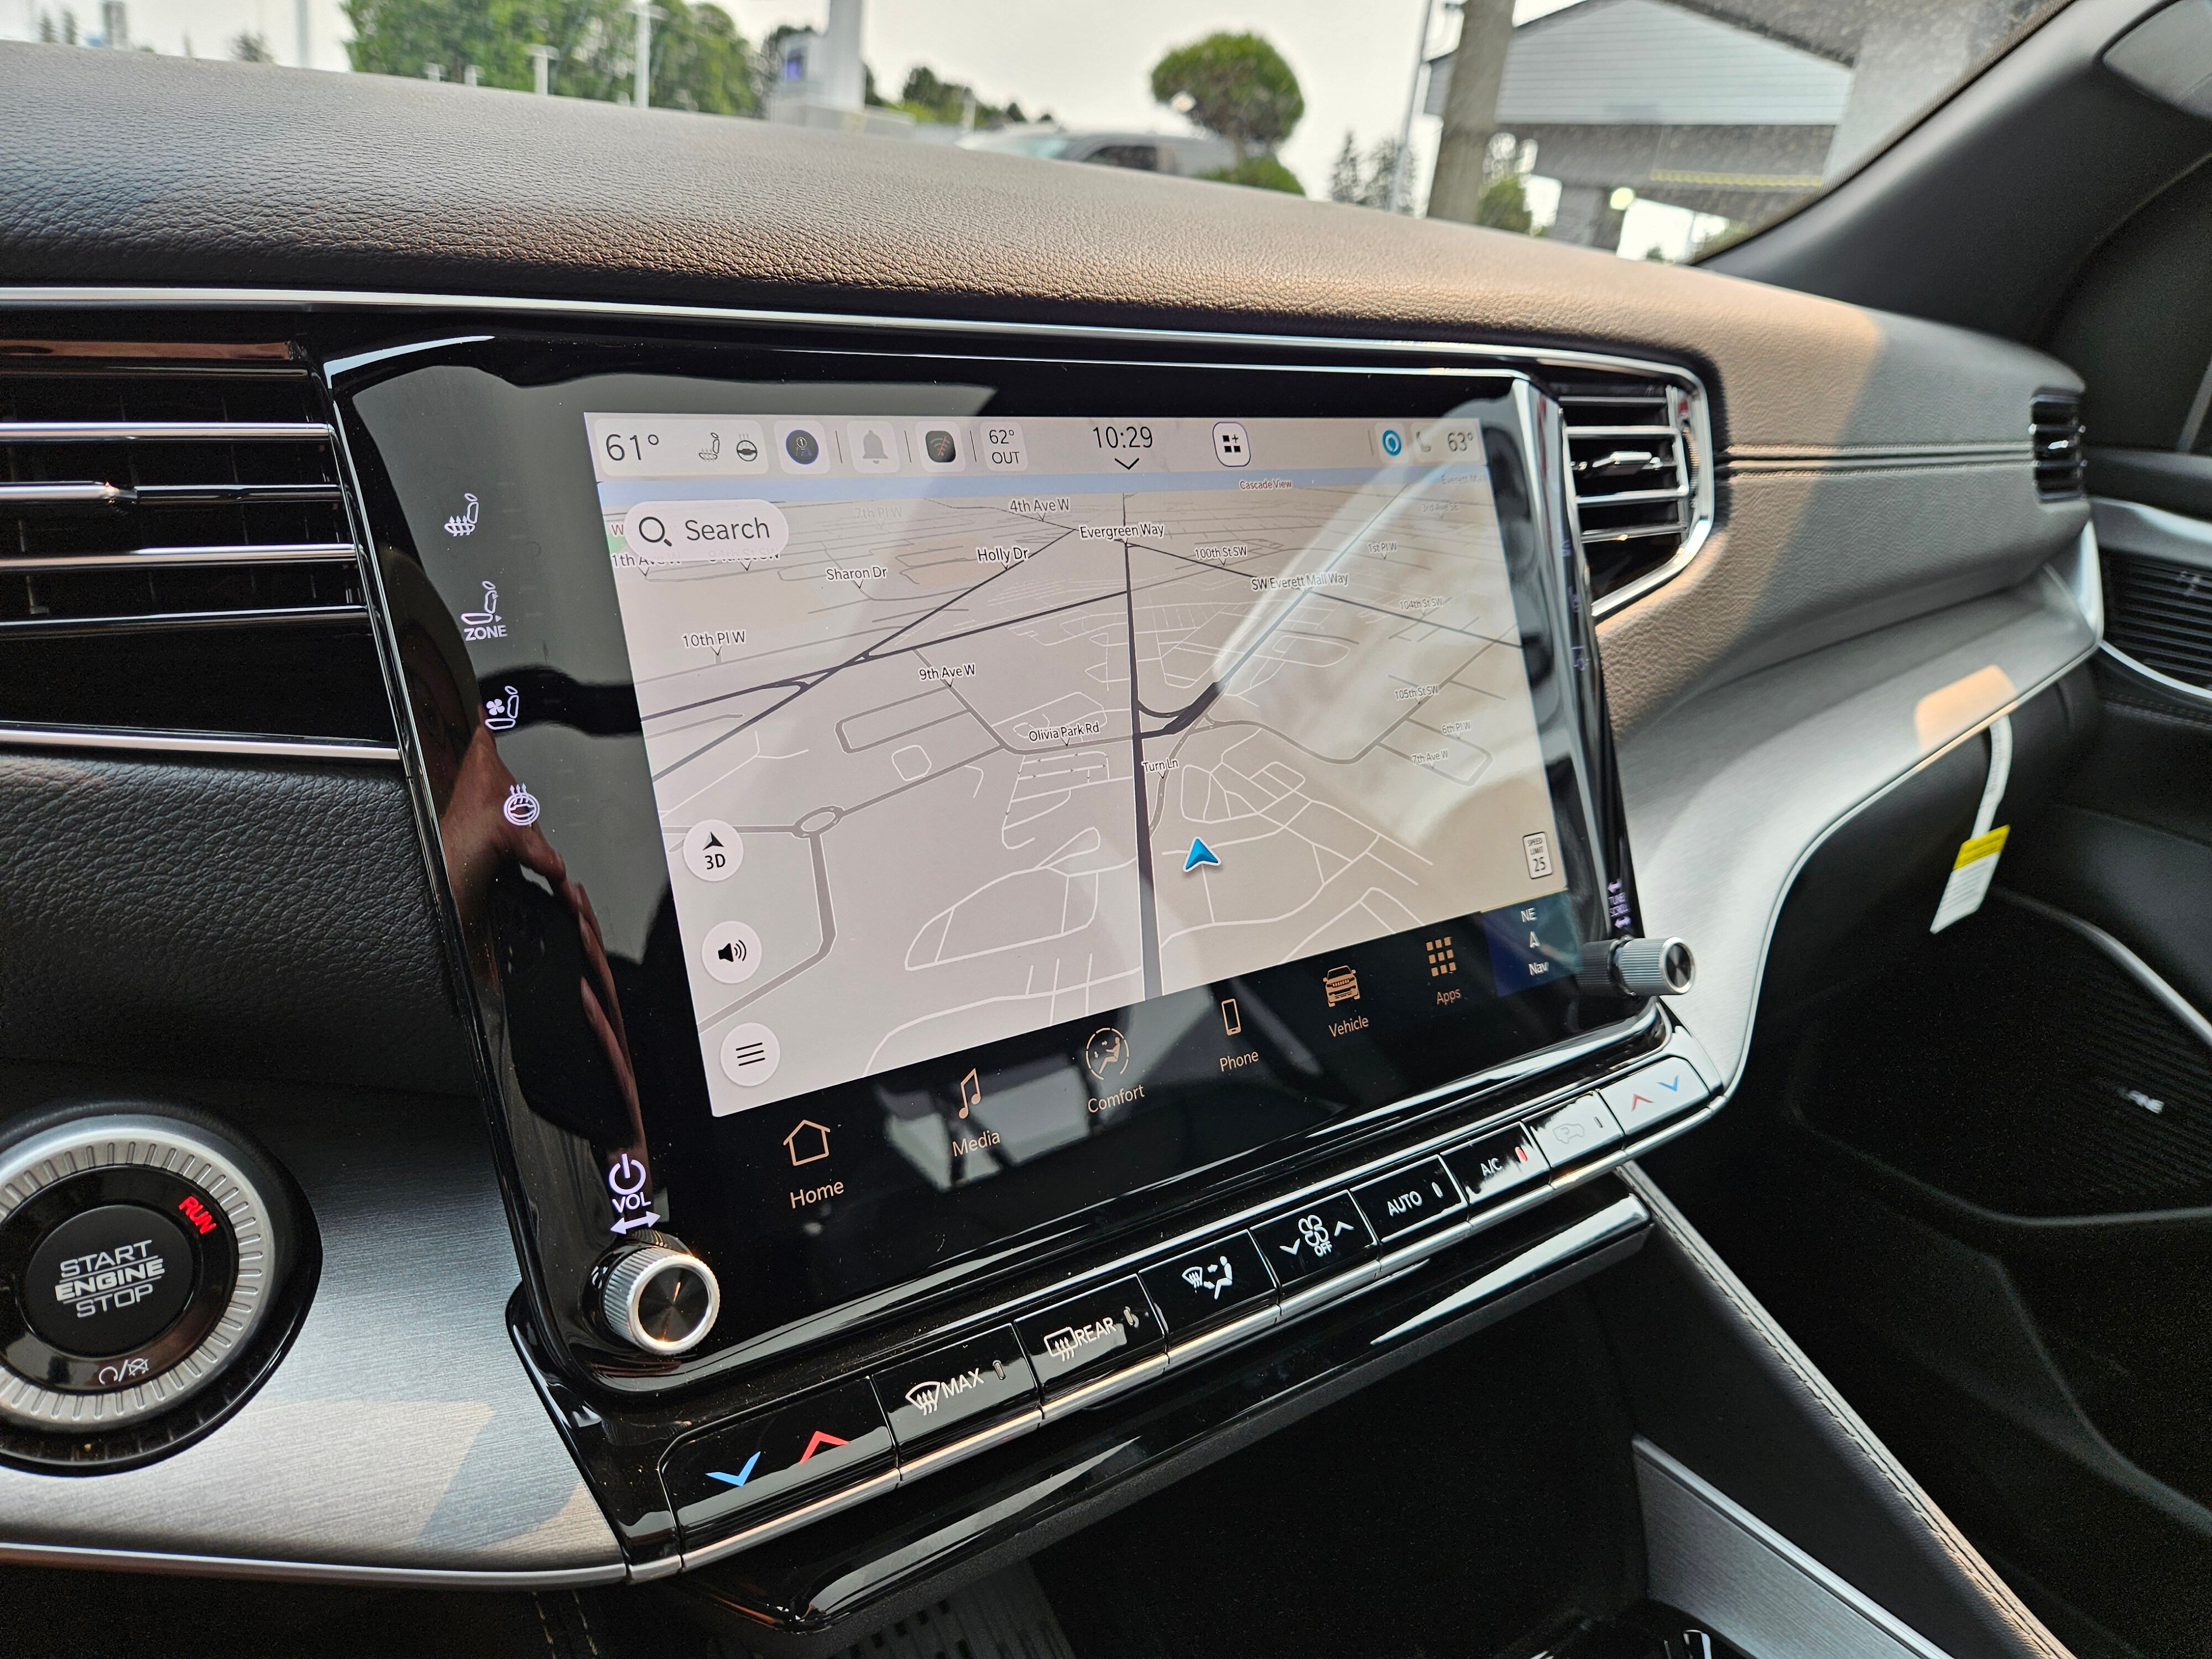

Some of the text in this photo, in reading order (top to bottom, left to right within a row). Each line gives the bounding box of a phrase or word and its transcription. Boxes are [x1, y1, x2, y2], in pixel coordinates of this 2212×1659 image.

[1093, 426, 1153, 448] 10:29
[992, 451, 1020, 464] OUT
[1240, 479, 1292, 489] Cascade View
[855, 508, 875, 519] 7th
[891, 507, 902, 518] W
[1010, 499, 1070, 512] 4th Ave W
[685, 517, 770, 541] Search
[1080, 524, 1164, 541] Evergreen Way
[977, 547, 1028, 563] Holly Dr
[1195, 546, 1247, 559] 100th St SW
[1368, 544, 1380, 553] 1st
[1389, 542, 1397, 551] W
[827, 566, 886, 580] Sharon Dr
[1251, 573, 1348, 590] SW Everett Mall Way
[1400, 597, 1442, 610] 104th St SW
[464, 625, 508, 641] ZONE
[683, 631, 745, 648] 10th Pl W
[919, 664, 976, 680] 9th Ave W
[1394, 685, 1438, 700] 105th St SW
[1029, 723, 1100, 742] Olivia Park Rd
[1442, 724, 1454, 734] 6th
[1463, 722, 1471, 731] W
[1412, 750, 1449, 764] 7th Ave W
[1144, 759, 1178, 773] Turn Ln
[1527, 837, 1543, 847] SPEED
[1530, 846, 1543, 855] LIMIT
[705, 853, 726, 869] 3D
[1532, 857, 1546, 872] 25
[1521, 907, 1537, 922] NE
[1528, 962, 1549, 975] Nav
[1436, 988, 1461, 1005] Apps
[1329, 1015, 1369, 1037] Vehicle
[1219, 1051, 1259, 1072] Phone
[1087, 1084, 1145, 1113] Comfort
[952, 1131, 1000, 1156] Media
[1480, 1158, 1503, 1177] A/C
[612, 1192, 651, 1213] VOL
[790, 1180, 844, 1209] Home
[1387, 1191, 1423, 1217] AUTO
[179, 1196, 217, 1234] RUN
[1314, 1241, 1333, 1258] OFF
[60, 1239, 152, 1278] START
[55, 1258, 165, 1301] ENGINE
[76, 1285, 153, 1318] STOP
[1076, 1317, 1118, 1347] REAR
[941, 1368, 984, 1399] MAX
